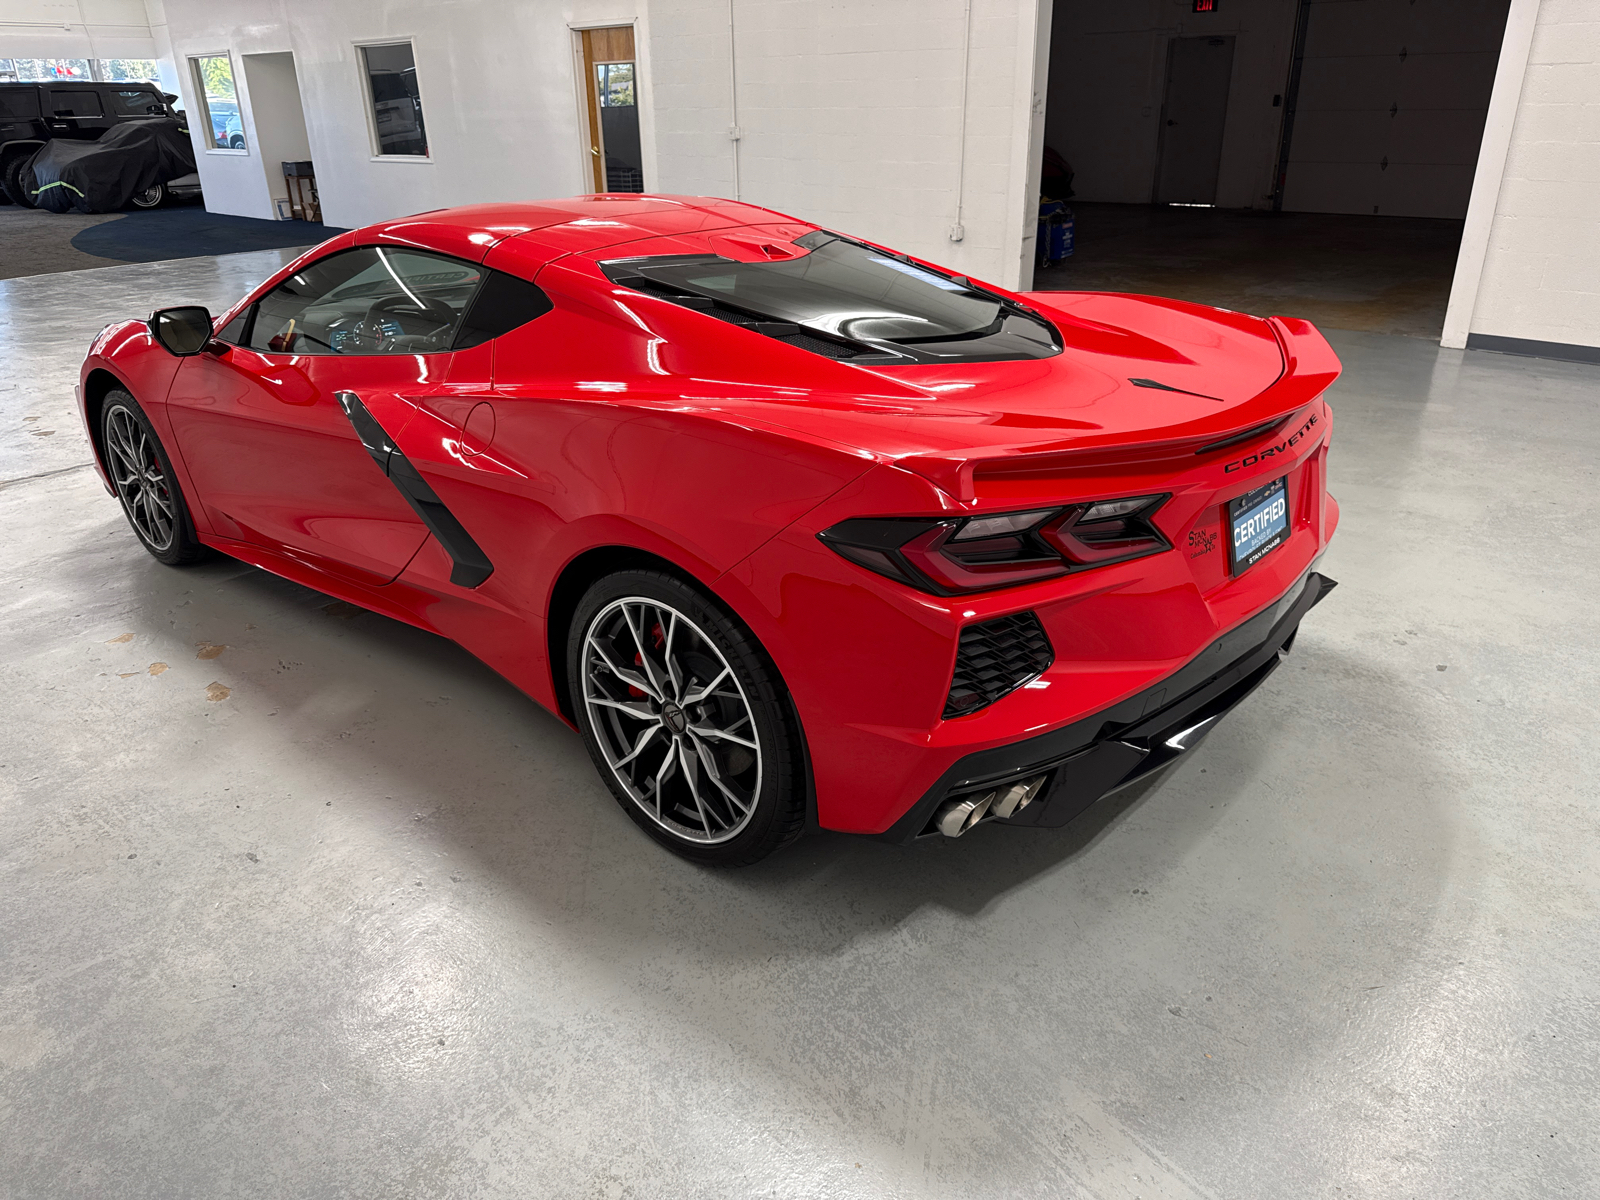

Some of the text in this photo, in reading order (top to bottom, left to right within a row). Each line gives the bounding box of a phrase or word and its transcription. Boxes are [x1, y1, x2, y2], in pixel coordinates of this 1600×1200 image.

[1196, 0, 1213, 11] EXIT
[1225, 413, 1318, 473] CORVETTE
[1188, 529, 1206, 546] STAN
[1234, 498, 1286, 547] CERTIFIED
[1249, 550, 1262, 565] STAN
[705, 619, 759, 697] MICHELIN
